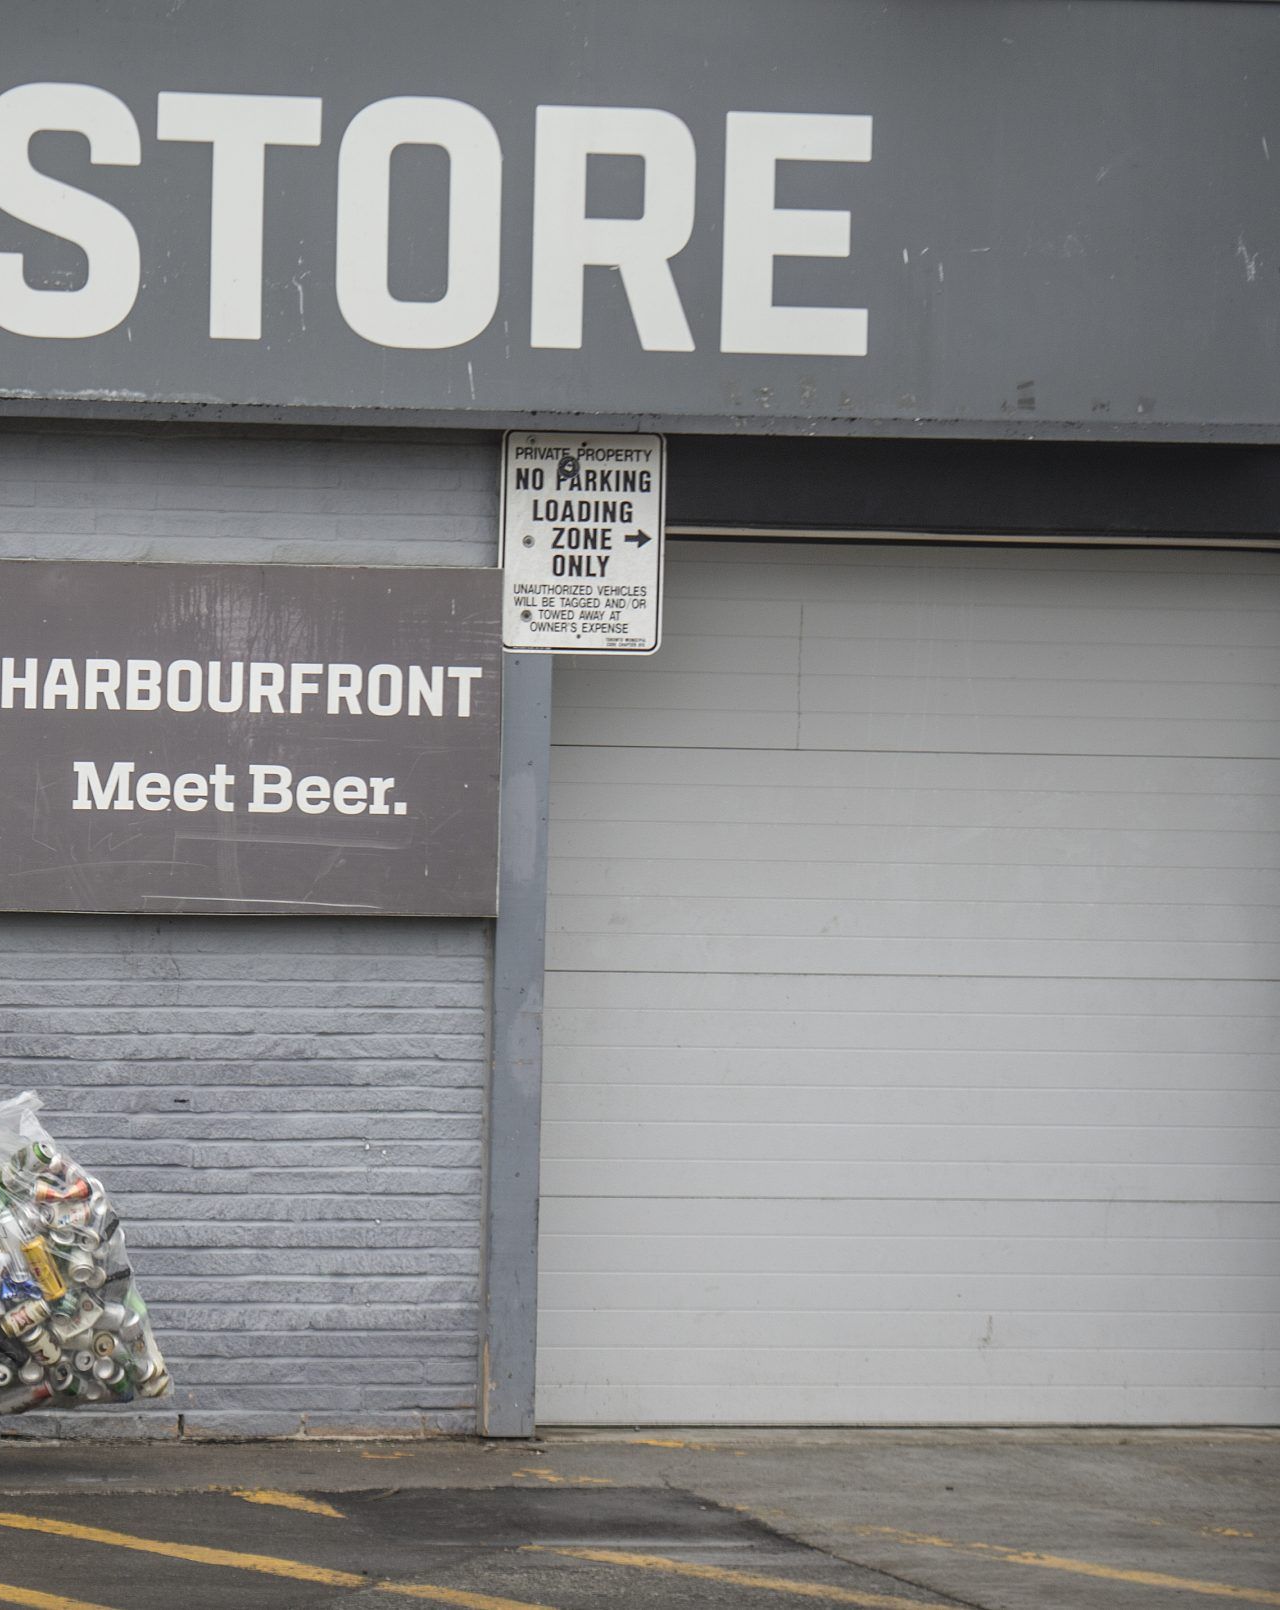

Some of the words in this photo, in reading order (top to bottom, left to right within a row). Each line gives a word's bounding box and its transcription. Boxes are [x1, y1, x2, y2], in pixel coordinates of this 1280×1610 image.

[515, 447, 569, 460] PRIVATE
[577, 448, 653, 462] PROPERTY
[516, 467, 544, 490] NO
[556, 469, 652, 493] PARKING
[533, 499, 633, 523] LOADING
[551, 527, 612, 550] ZONE
[552, 554, 610, 577] ONLY
[513, 584, 593, 596] UNAUTHORIZED
[597, 585, 647, 597] VEHICLES
[514, 596, 537, 608] WILL
[542, 597, 555, 608] BE
[560, 597, 600, 609] TAGGED
[605, 598, 647, 610] AND/OR
[539, 609, 574, 621] TOWED
[579, 610, 605, 621] AWAY
[609, 611, 621, 621] AT
[530, 621, 577, 633] OWNER'S
[582, 622, 629, 634] EXPENSE
[0, 656, 482, 718] HARBOURFRONT
[72, 760, 234, 813] Meet
[248, 764, 407, 815] Beer.
